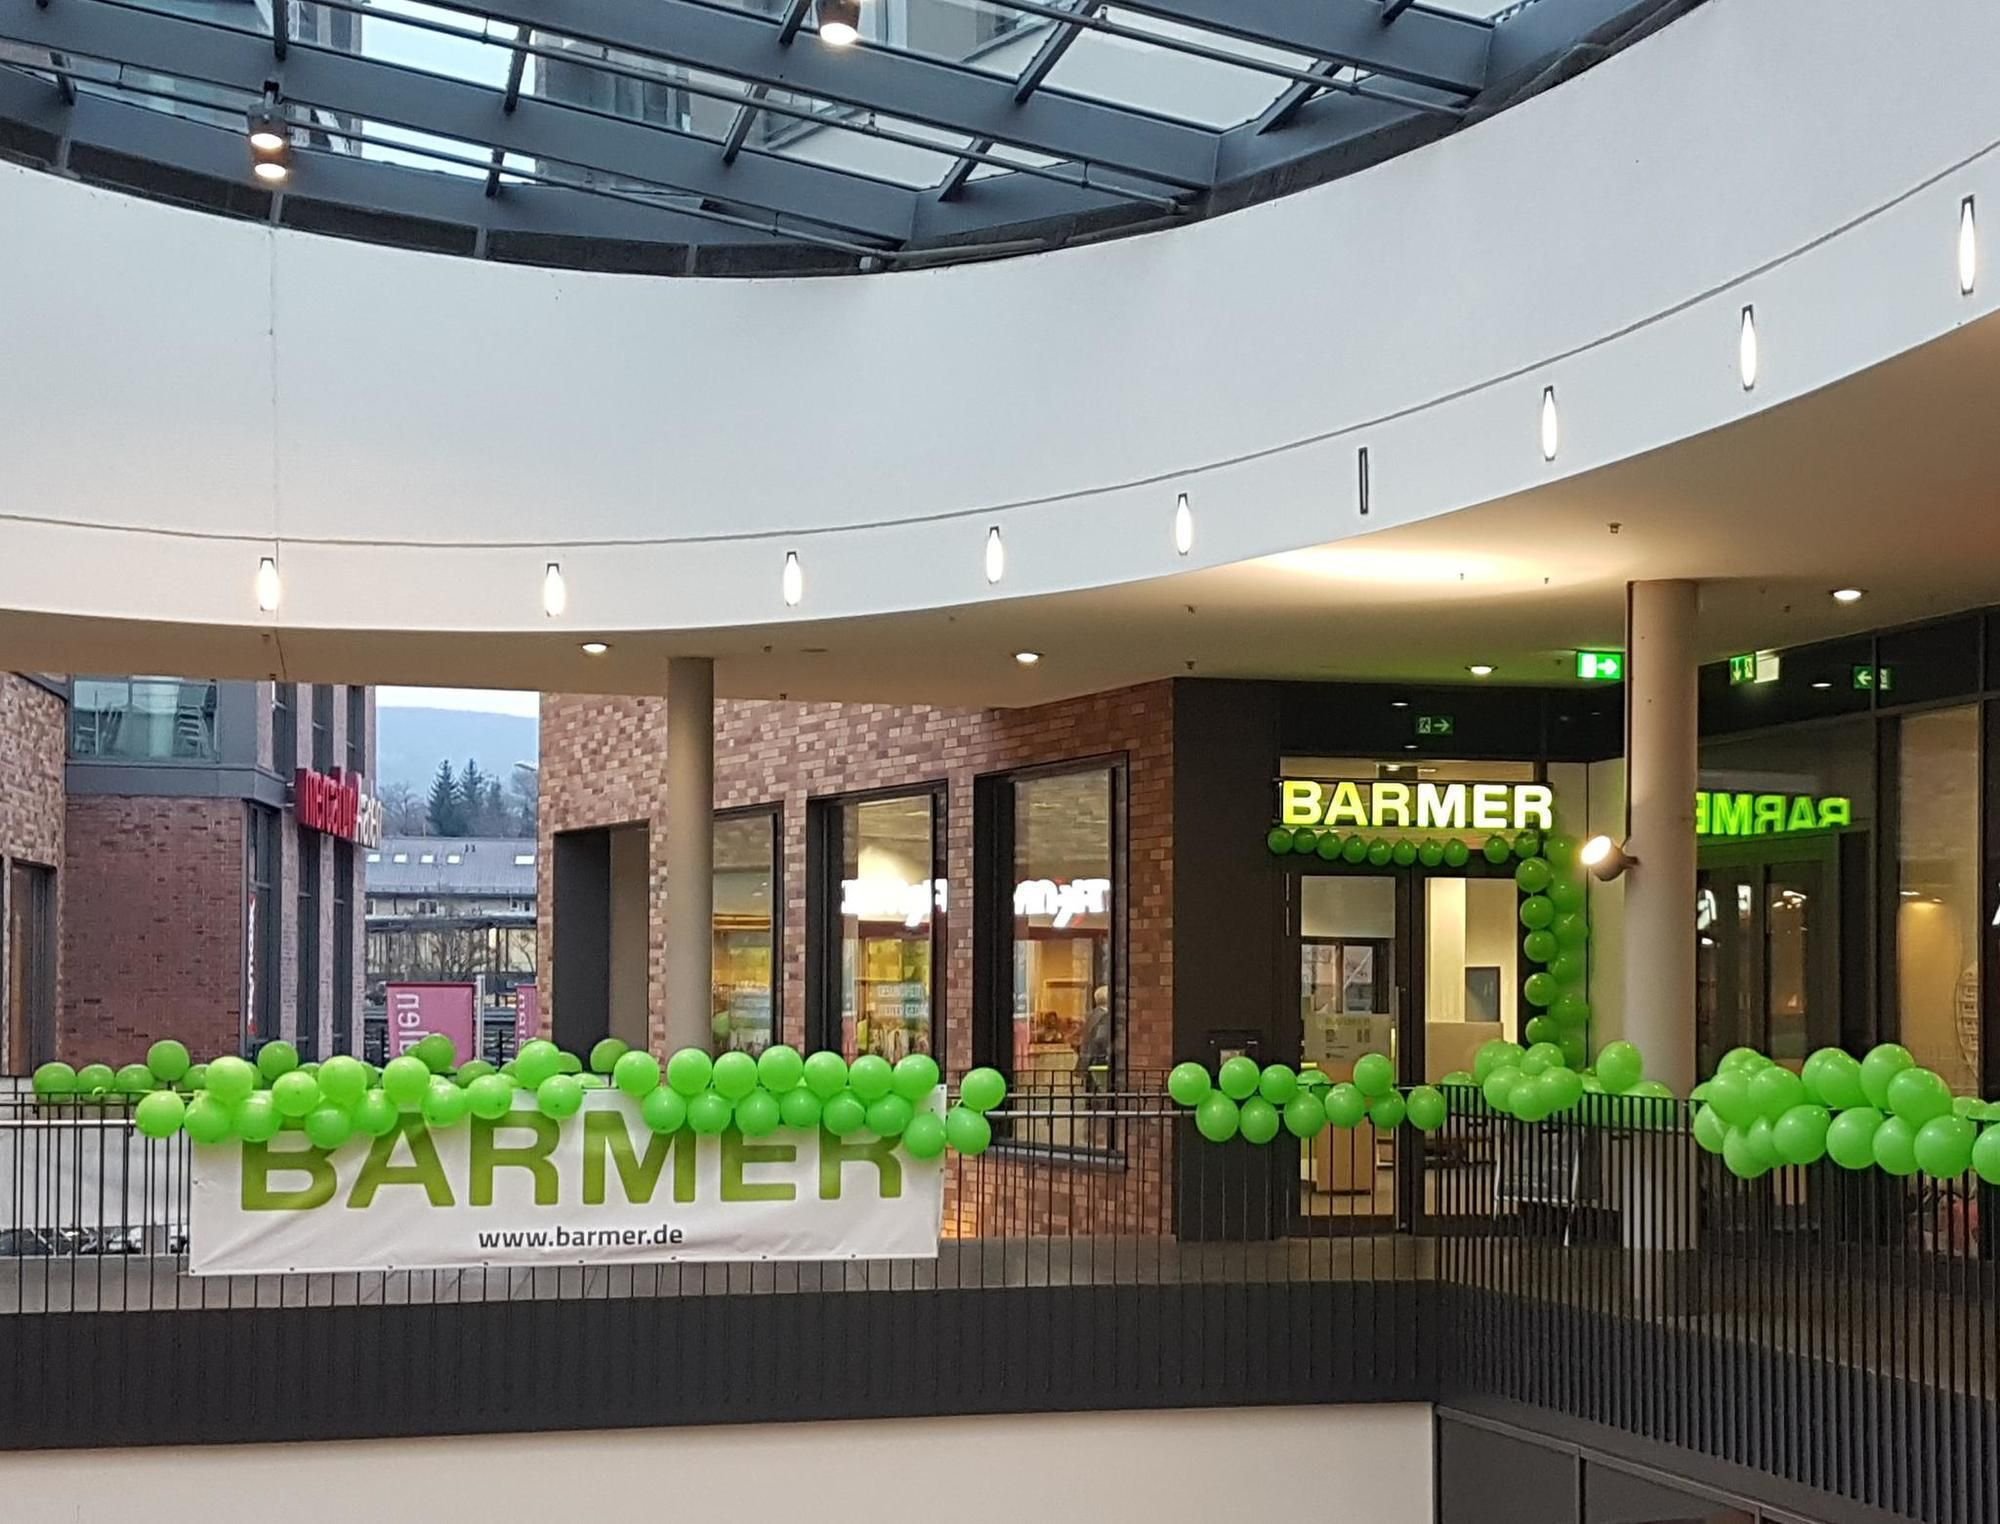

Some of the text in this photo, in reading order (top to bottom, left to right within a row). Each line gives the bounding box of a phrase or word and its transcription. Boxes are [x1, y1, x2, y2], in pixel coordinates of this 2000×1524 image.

[1282, 781, 1552, 829] BARMER
[241, 1110, 902, 1210] BARMER
[478, 1224, 683, 1248] www.barmer.de
